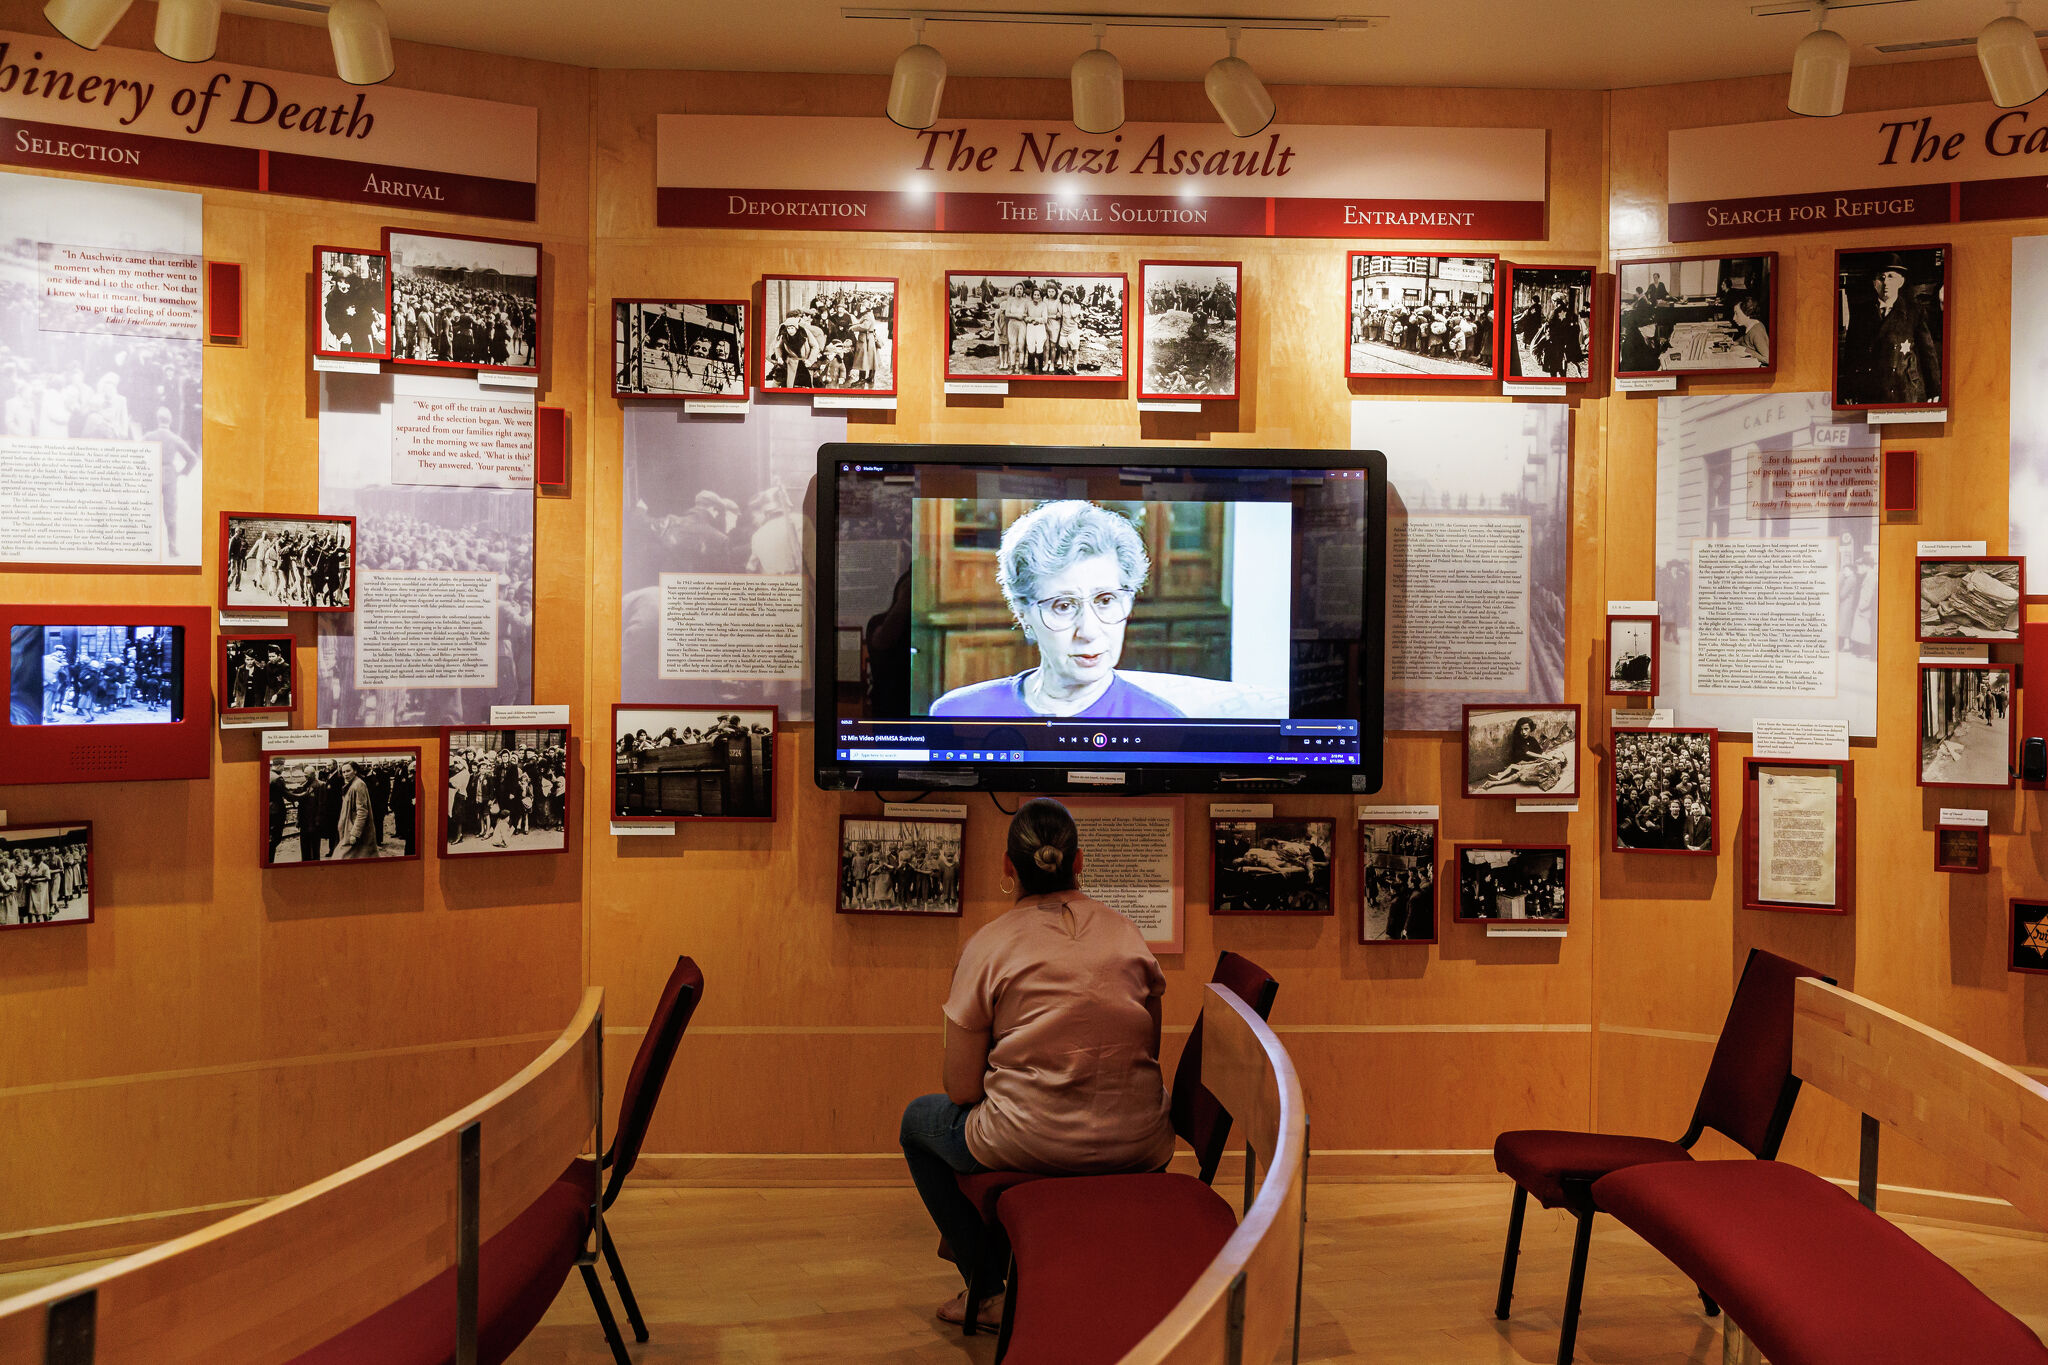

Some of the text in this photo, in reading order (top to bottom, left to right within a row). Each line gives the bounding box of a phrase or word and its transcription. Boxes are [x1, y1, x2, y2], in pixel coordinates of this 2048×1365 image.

[171, 74, 230, 133] of
[231, 80, 375, 139] Death
[1877, 116, 1965, 165] The
[916, 128, 1296, 177] The Nazi Assault
[80, 252, 122, 262] Auschwitz
[168, 259, 197, 268] terrible
[135, 270, 164, 278] mother
[66, 276, 81, 284] side
[163, 283, 178, 291] Not
[182, 285, 197, 293] that
[160, 297, 197, 305] somehow
[111, 305, 123, 313] the
[126, 306, 154, 317] feeling
[431, 403, 442, 411] got
[498, 406, 532, 415] Auschwitz
[417, 413, 430, 421] and
[447, 414, 476, 423] selection
[479, 416, 501, 426] began.
[397, 424, 430, 432] separated
[433, 425, 449, 433] from
[466, 427, 493, 435] families
[496, 429, 511, 438] right
[437, 438, 467, 448] morning
[496, 440, 517, 448] flames
[508, 452, 512, 460] is
[1823, 455, 1836, 463] and
[1840, 454, 1878, 463] thousands
[418, 460, 436, 468] They
[1753, 467, 1761, 475] of
[1799, 468, 1817, 477] piece
[1831, 468, 1852, 477] paper
[1855, 466, 1871, 474] with
[1773, 480, 1794, 488] stamp
[1826, 478, 1838, 486] the
[1841, 478, 1878, 486] difference
[1785, 490, 1816, 498] between
[1819, 489, 1830, 497] life
